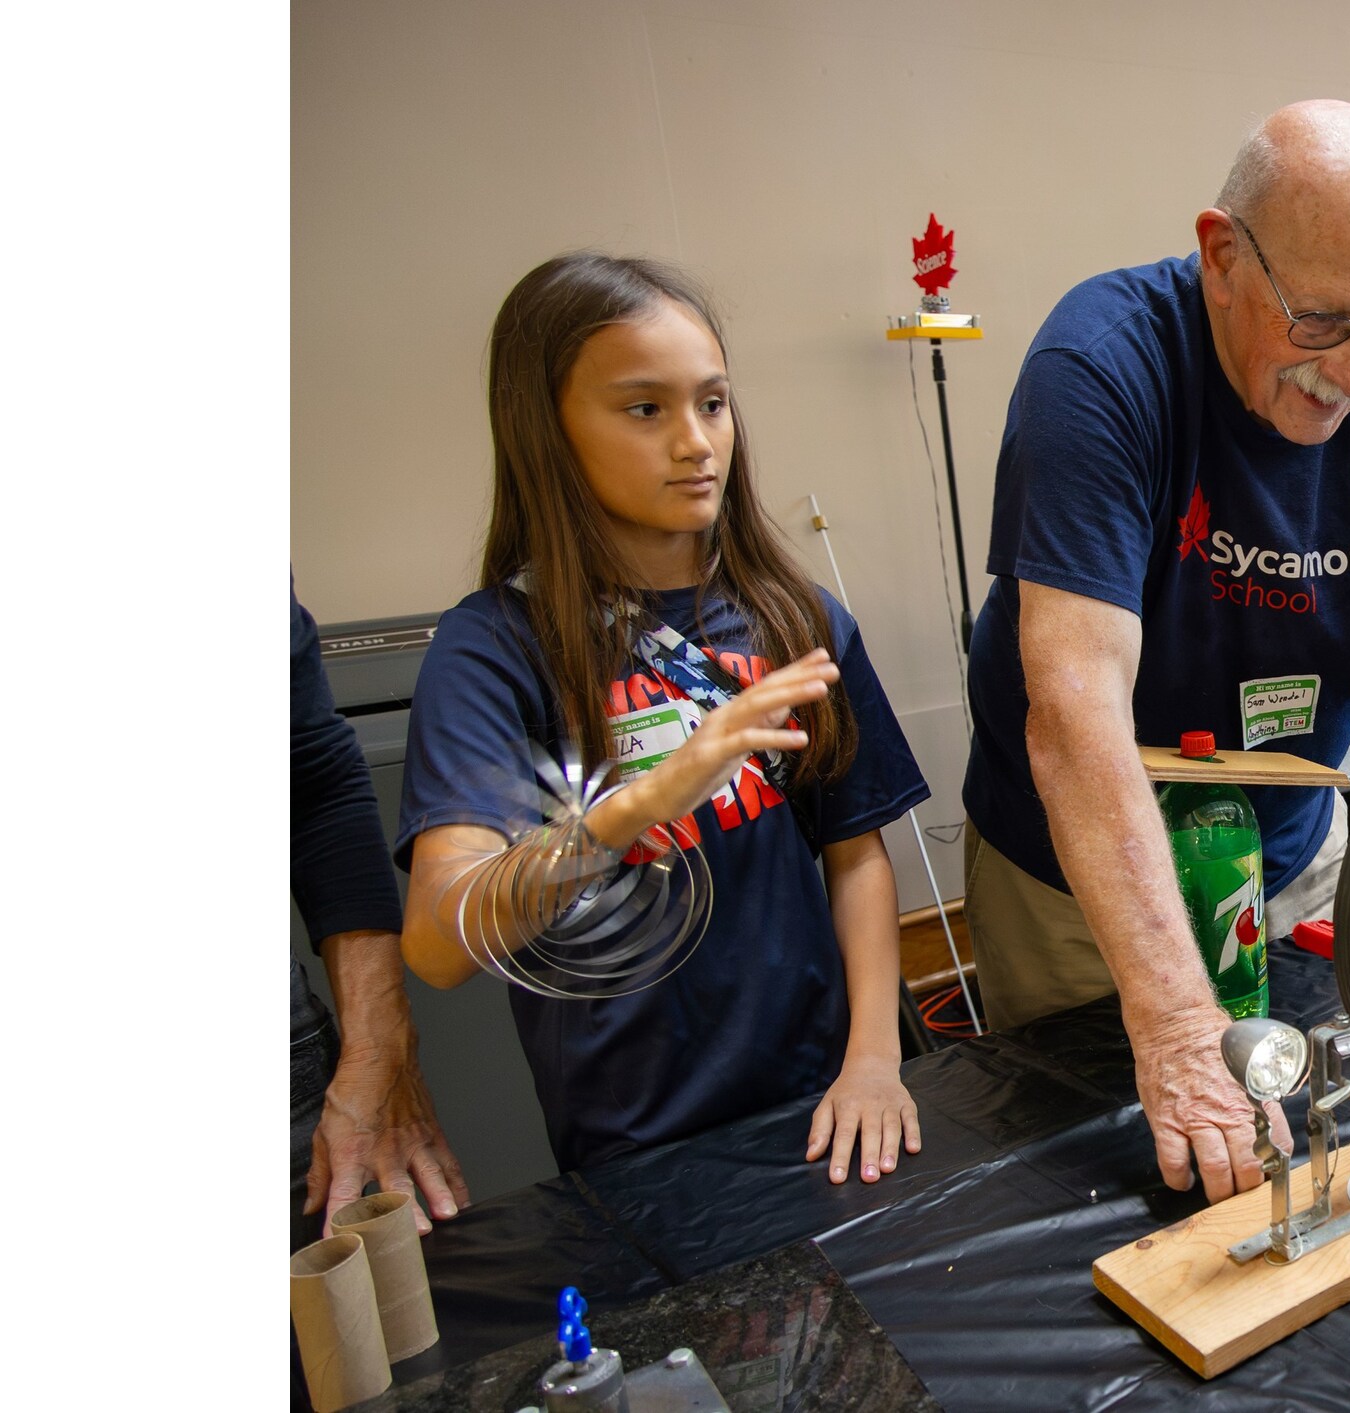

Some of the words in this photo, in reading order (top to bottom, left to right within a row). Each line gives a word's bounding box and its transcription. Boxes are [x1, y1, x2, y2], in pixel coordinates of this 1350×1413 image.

[917, 250, 947, 276] Science
[1211, 569, 1317, 614] School
[329, 638, 385, 649] TRASH
[1276, 682, 1294, 690] name
[625, 719, 650, 731] name
[651, 716, 661, 725] is
[1284, 719, 1304, 727] STEM
